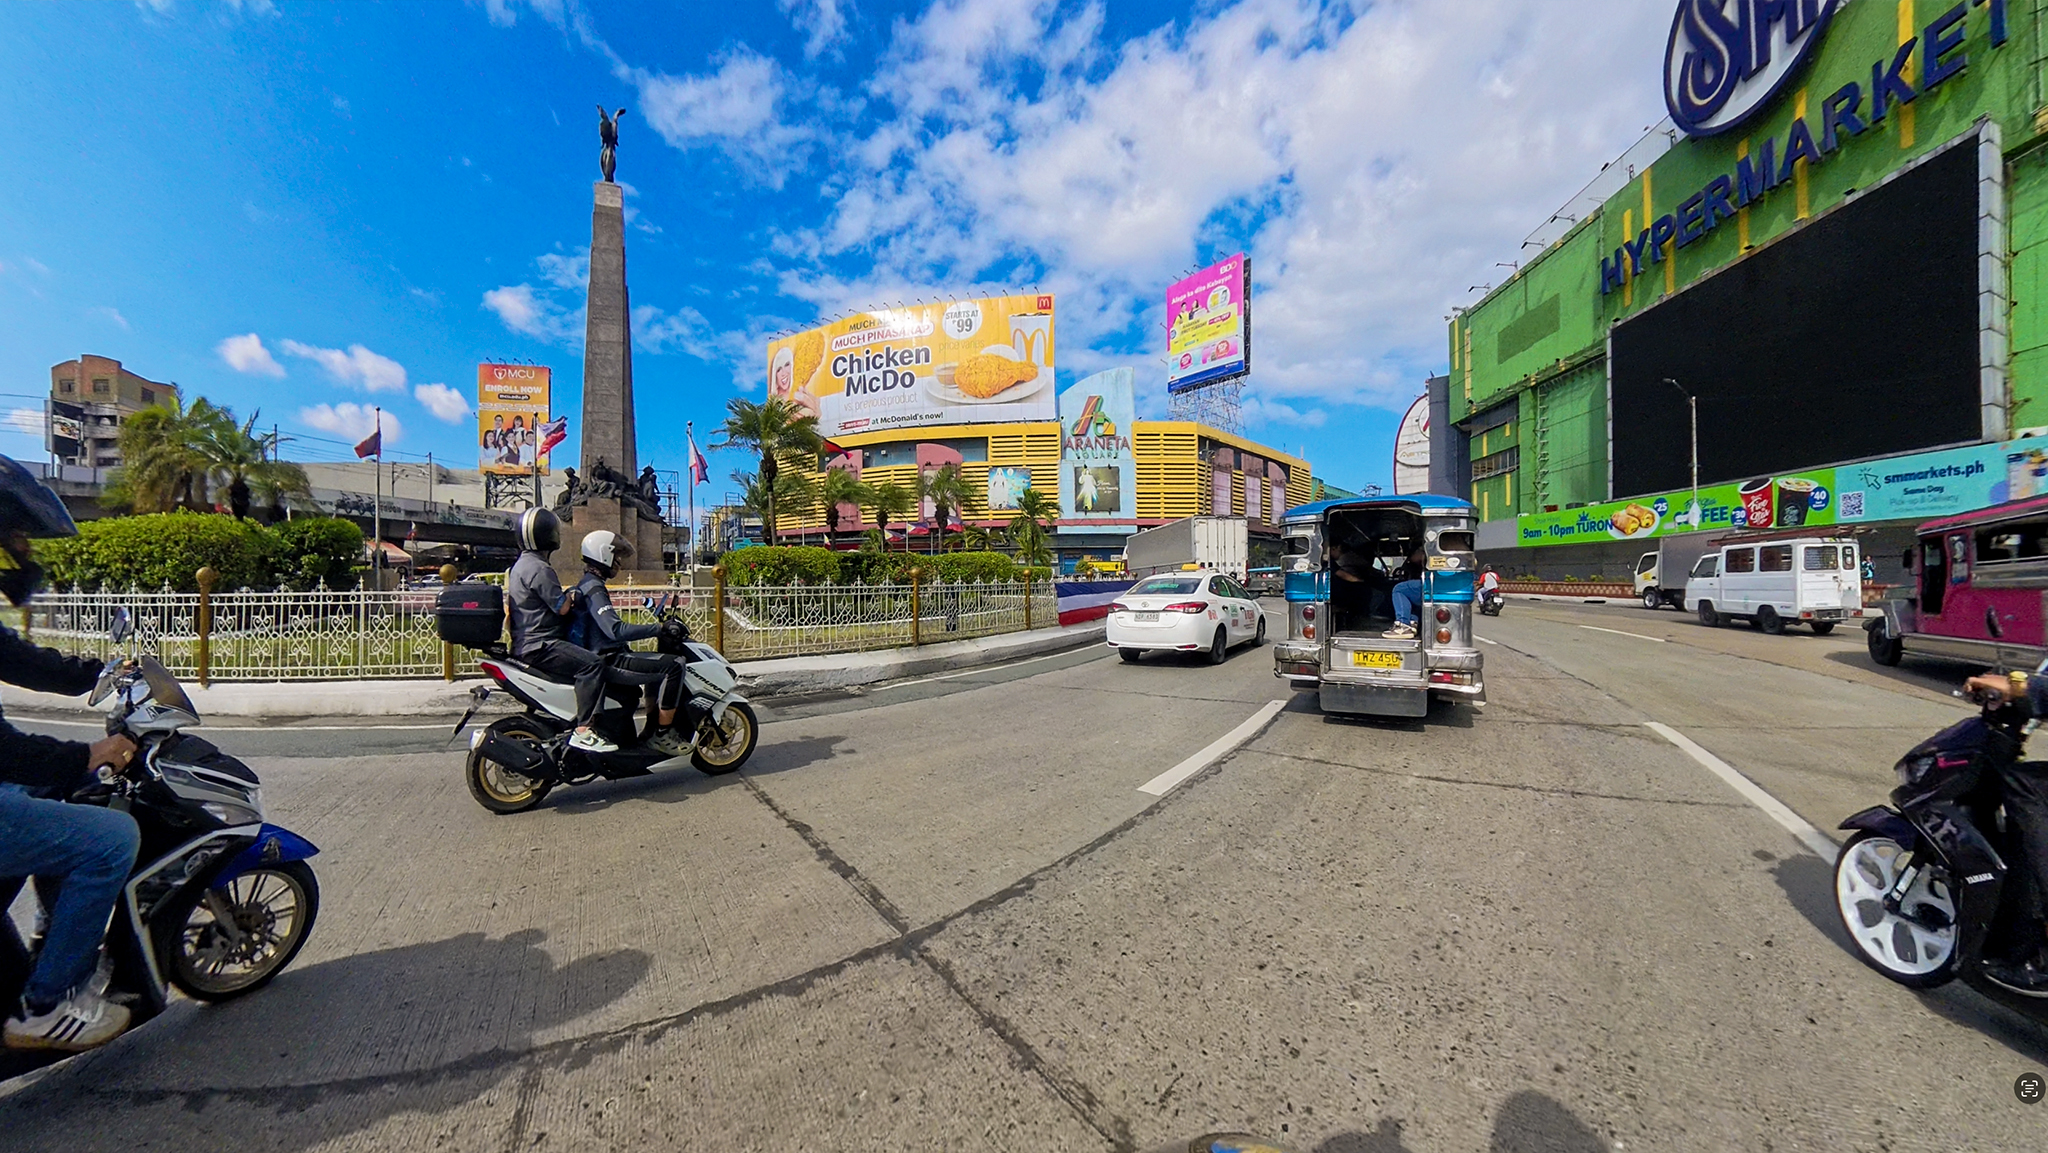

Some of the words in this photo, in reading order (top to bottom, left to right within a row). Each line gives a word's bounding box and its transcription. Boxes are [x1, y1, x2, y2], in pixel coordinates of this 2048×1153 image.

[1601, 0, 2009, 295] HYPERMARKET
[1220, 261, 1237, 275] BDO
[1206, 274, 1233, 290] Kabayan
[945, 310, 969, 320] STARTS
[970, 309, 979, 318] AT
[849, 319, 876, 331] MUCH
[834, 334, 866, 349] MUCH
[938, 341, 959, 353] price
[832, 346, 930, 377] Chicken
[507, 369, 535, 379] MCU
[485, 384, 519, 393] ENROLL
[520, 386, 543, 394] NOW
[846, 369, 915, 397] McDo
[854, 397, 887, 411] previous
[887, 392, 917, 408] product
[880, 413, 924, 424] McDonald's
[924, 412, 944, 420] now!
[1063, 436, 1131, 451] ARANETA
[1884, 460, 1985, 484] smmarkets.ph
[1903, 487, 1926, 496] Same
[1926, 485, 1944, 493] Day
[1523, 528, 1542, 538] 9am
[1549, 524, 1575, 538] 10pm
[1576, 518, 1614, 533] TURON
[1356, 652, 1376, 662] TWZ
[1964, 872, 1995, 885] YAMAHA
